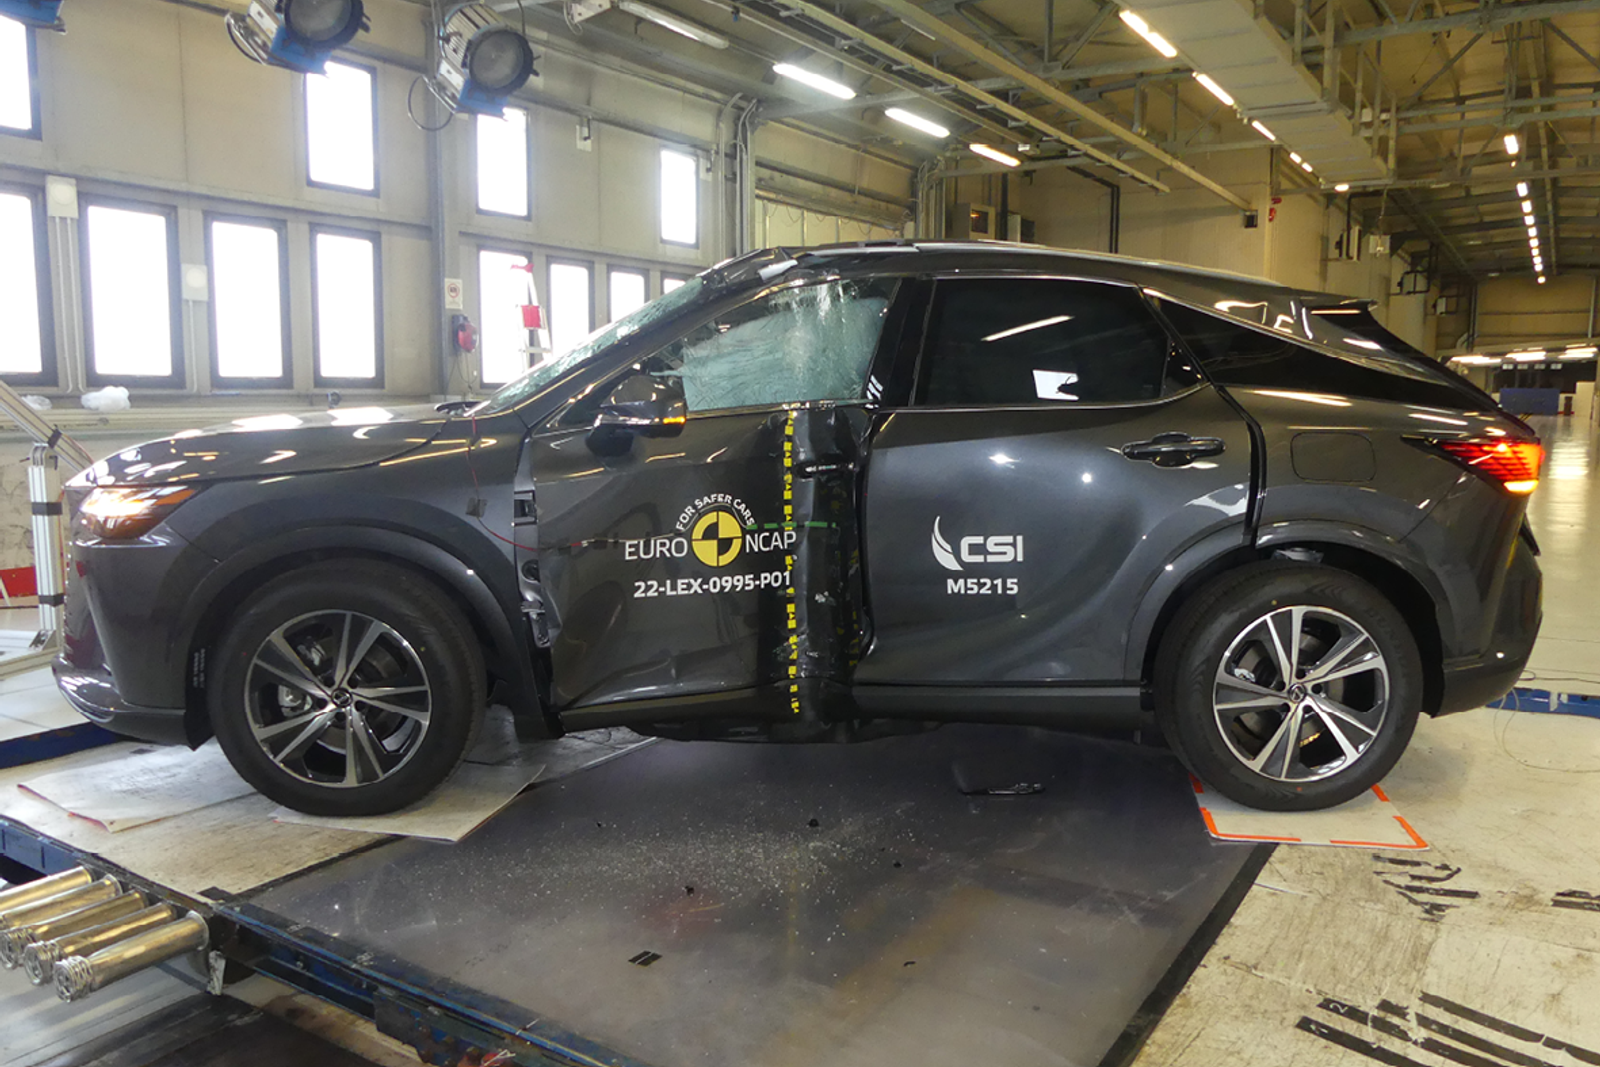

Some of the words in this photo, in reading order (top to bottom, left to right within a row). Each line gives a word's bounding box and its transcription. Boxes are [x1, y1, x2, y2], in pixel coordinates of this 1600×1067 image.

[675, 505, 696, 531] FOR
[694, 493, 732, 509] SAFER
[733, 498, 755, 526] CARS
[624, 537, 688, 560] EURO
[745, 531, 797, 553] NCAP
[960, 535, 1024, 563] CSI
[946, 578, 1019, 595] M5215
